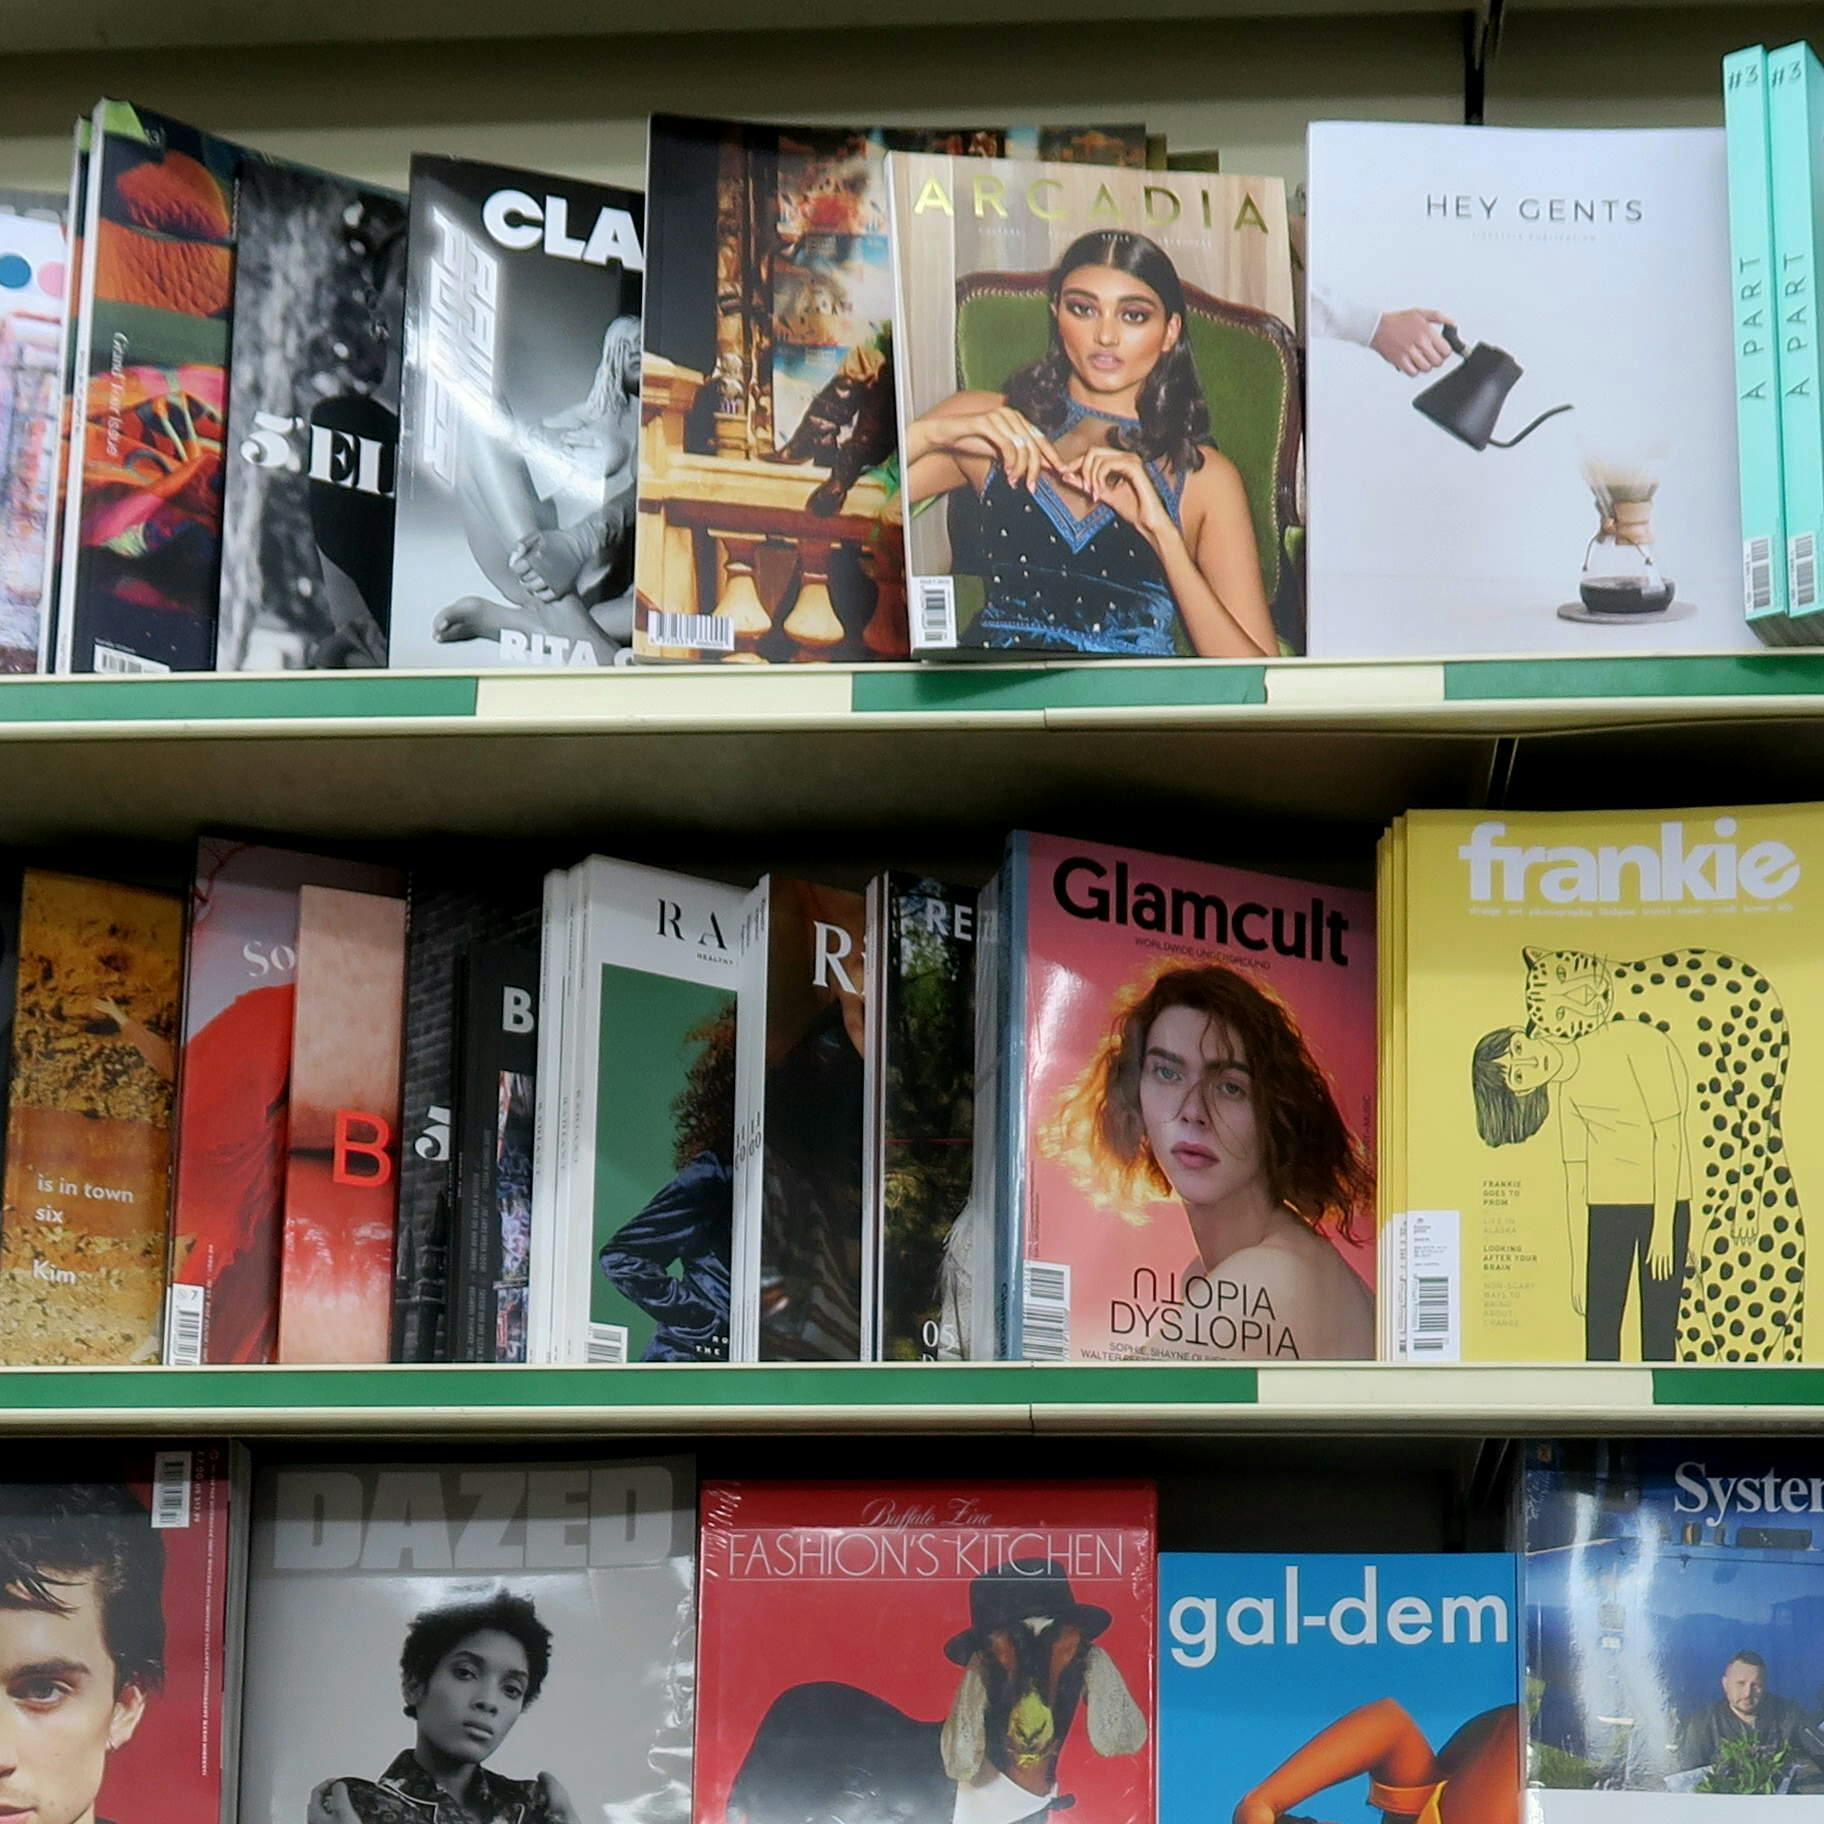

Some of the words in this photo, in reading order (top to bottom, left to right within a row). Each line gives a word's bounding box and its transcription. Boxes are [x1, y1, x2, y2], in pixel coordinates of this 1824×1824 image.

[912, 174, 1270, 235] ARCADIA
[1426, 194, 1500, 222] HEY
[1519, 198, 1644, 225] GENTS
[1458, 816, 1801, 905] frankie
[1052, 855, 1349, 968] Glamcult
[34, 1202, 65, 1225] six
[30, 1258, 77, 1287] Kim
[274, 1464, 674, 1572] DAZED
[729, 1533, 944, 1577] FASHION'S
[952, 1533, 1124, 1577] KITCHEN
[1168, 1564, 1509, 1669] gal-dem
